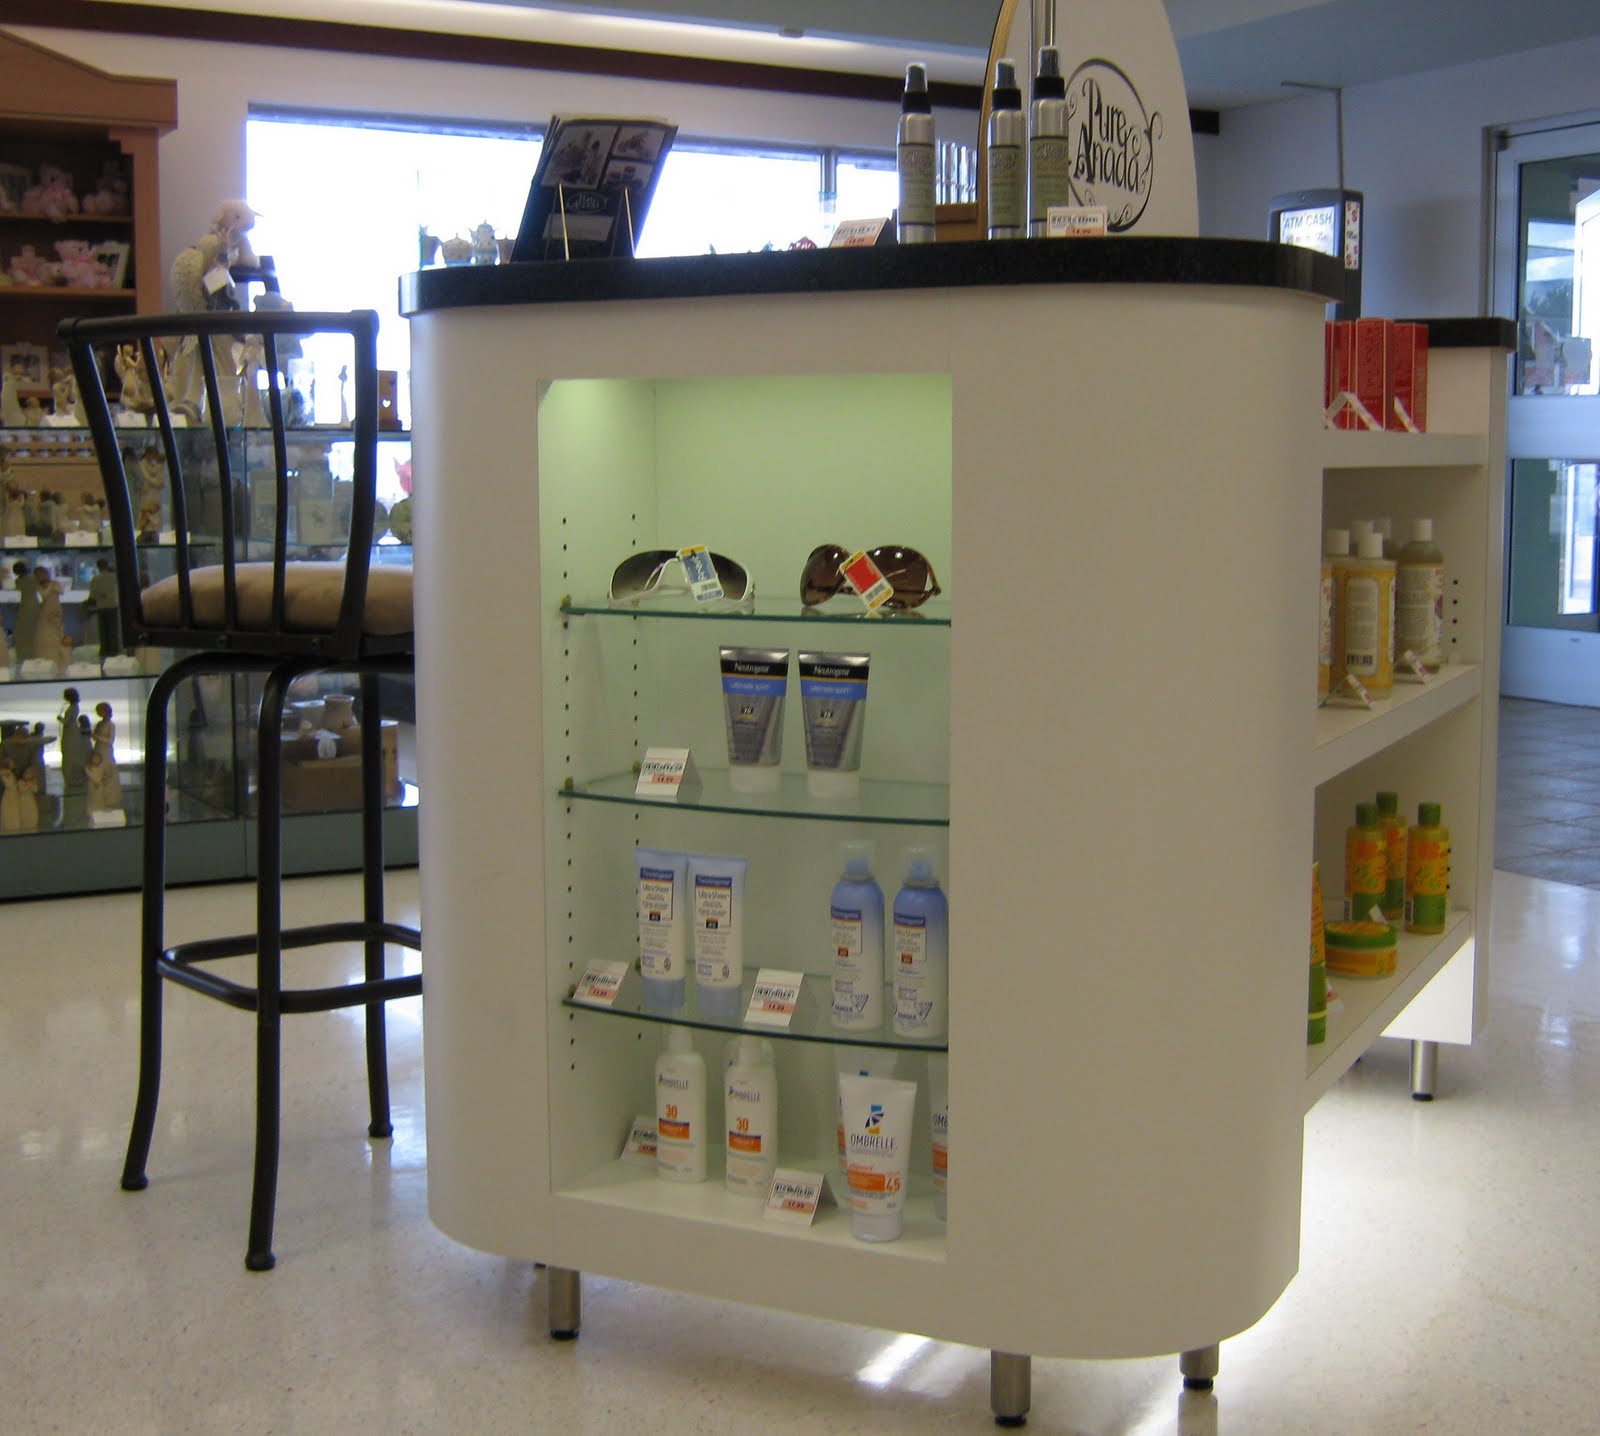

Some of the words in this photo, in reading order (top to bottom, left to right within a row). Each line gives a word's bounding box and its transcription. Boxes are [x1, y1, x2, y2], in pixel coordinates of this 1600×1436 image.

[1082, 77, 1130, 148] Pure
[1073, 121, 1142, 194] Anada
[1283, 216, 1303, 229] ATM
[1306, 211, 1333, 225] CASH
[665, 1104, 678, 1119] 30
[736, 1117, 750, 1132] 30
[850, 1133, 896, 1150] OMBRELLE
[885, 1177, 901, 1192] 45
